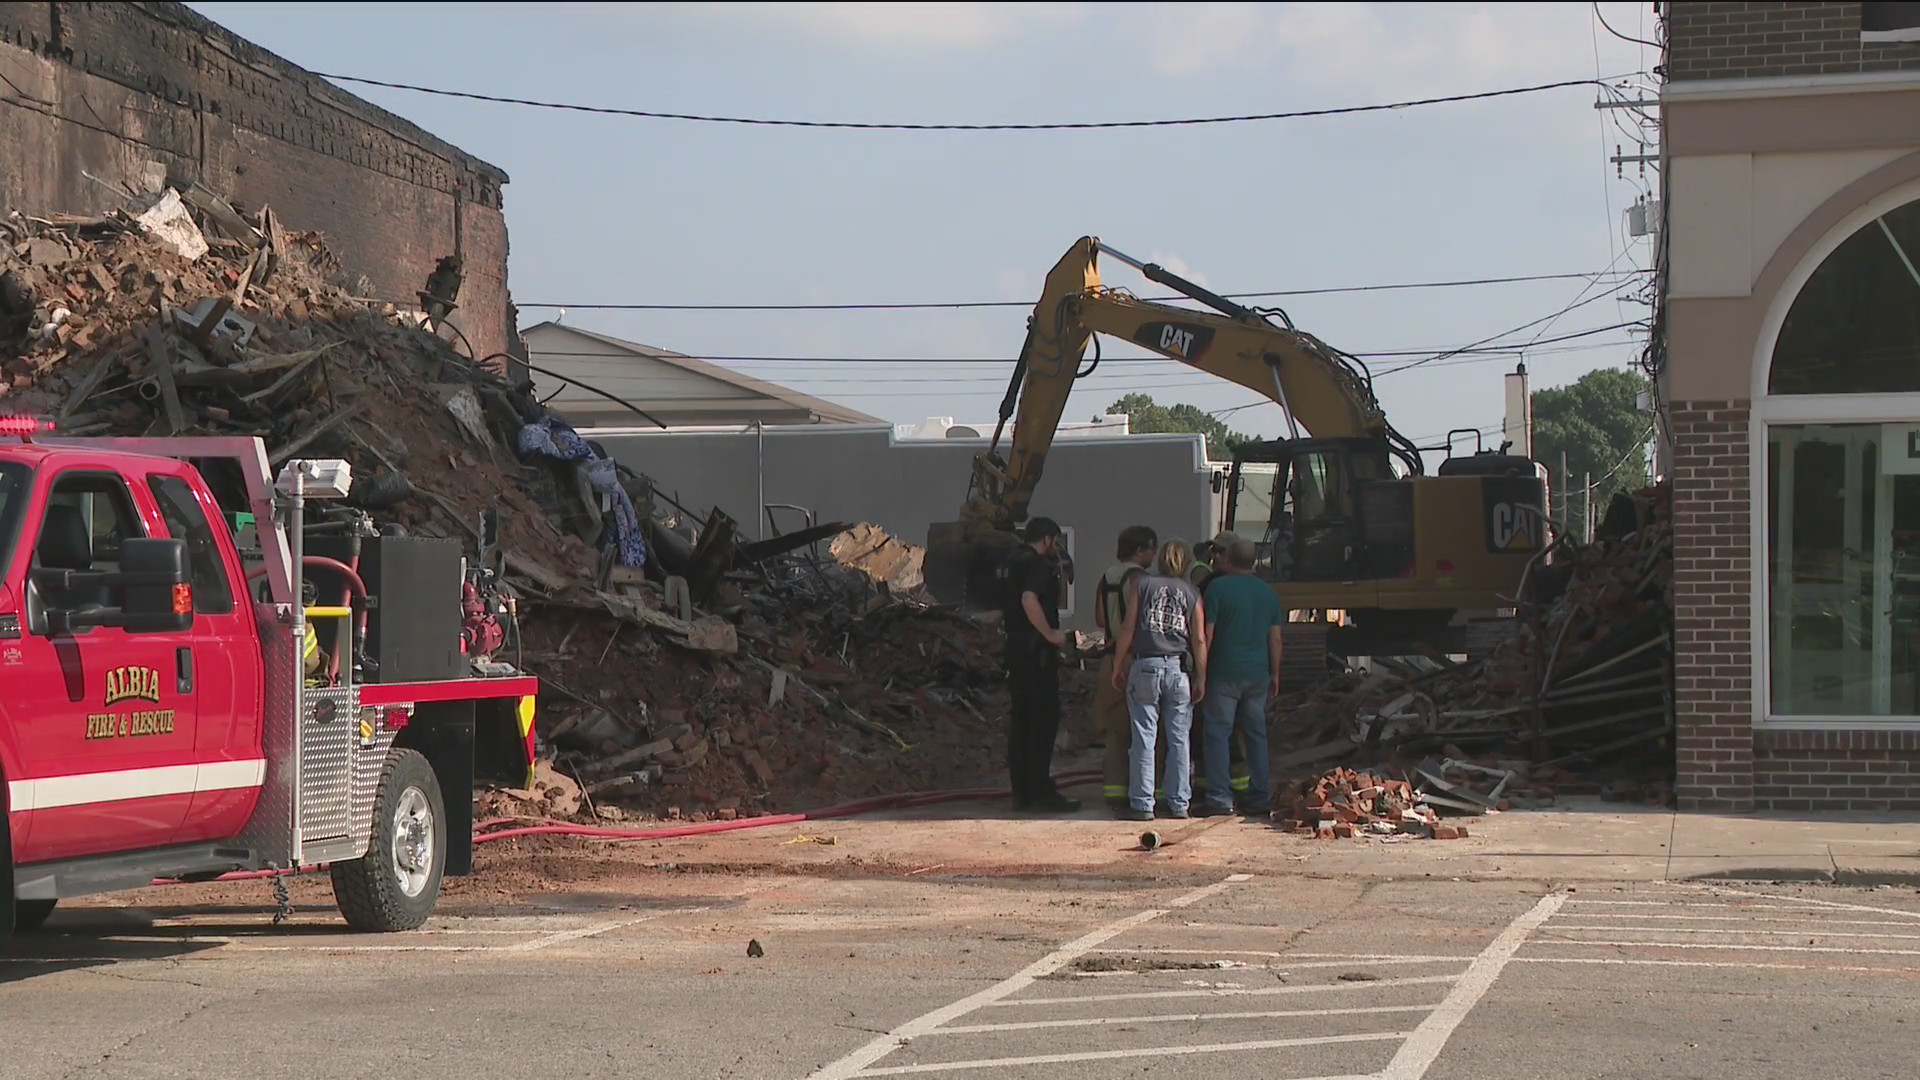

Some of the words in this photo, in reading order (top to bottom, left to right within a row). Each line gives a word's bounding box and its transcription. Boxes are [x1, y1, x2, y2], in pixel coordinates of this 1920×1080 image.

[1160, 324, 1194, 357] CAT
[105, 665, 160, 706] ALBIA
[86, 713, 116, 739] FIRE
[119, 712, 128, 736] &
[131, 709, 175, 735] RESCUE
